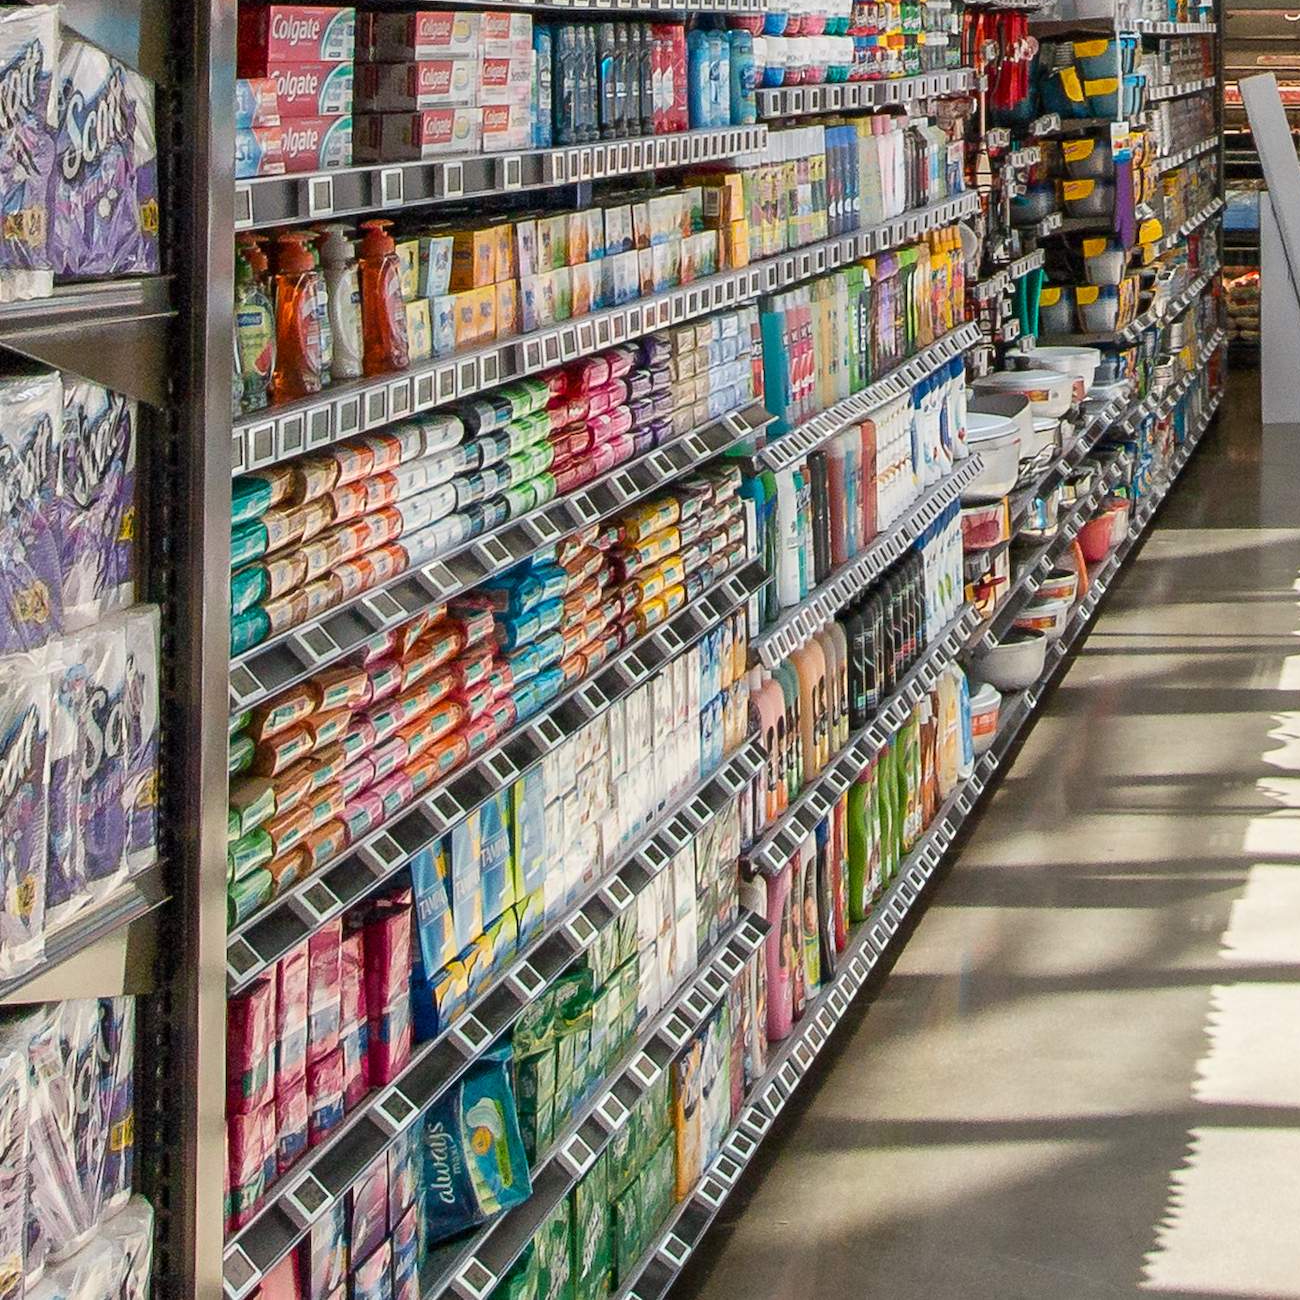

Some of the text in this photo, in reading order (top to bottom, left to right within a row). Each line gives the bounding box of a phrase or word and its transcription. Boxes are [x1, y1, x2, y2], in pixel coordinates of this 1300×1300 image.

[272, 13, 320, 46] Colgate
[420, 18, 451, 40] Colgate
[420, 68, 450, 90] Colgate
[425, 116, 452, 138] Colgate
[281, 127, 318, 158] olgate
[428, 1121, 456, 1204] always
